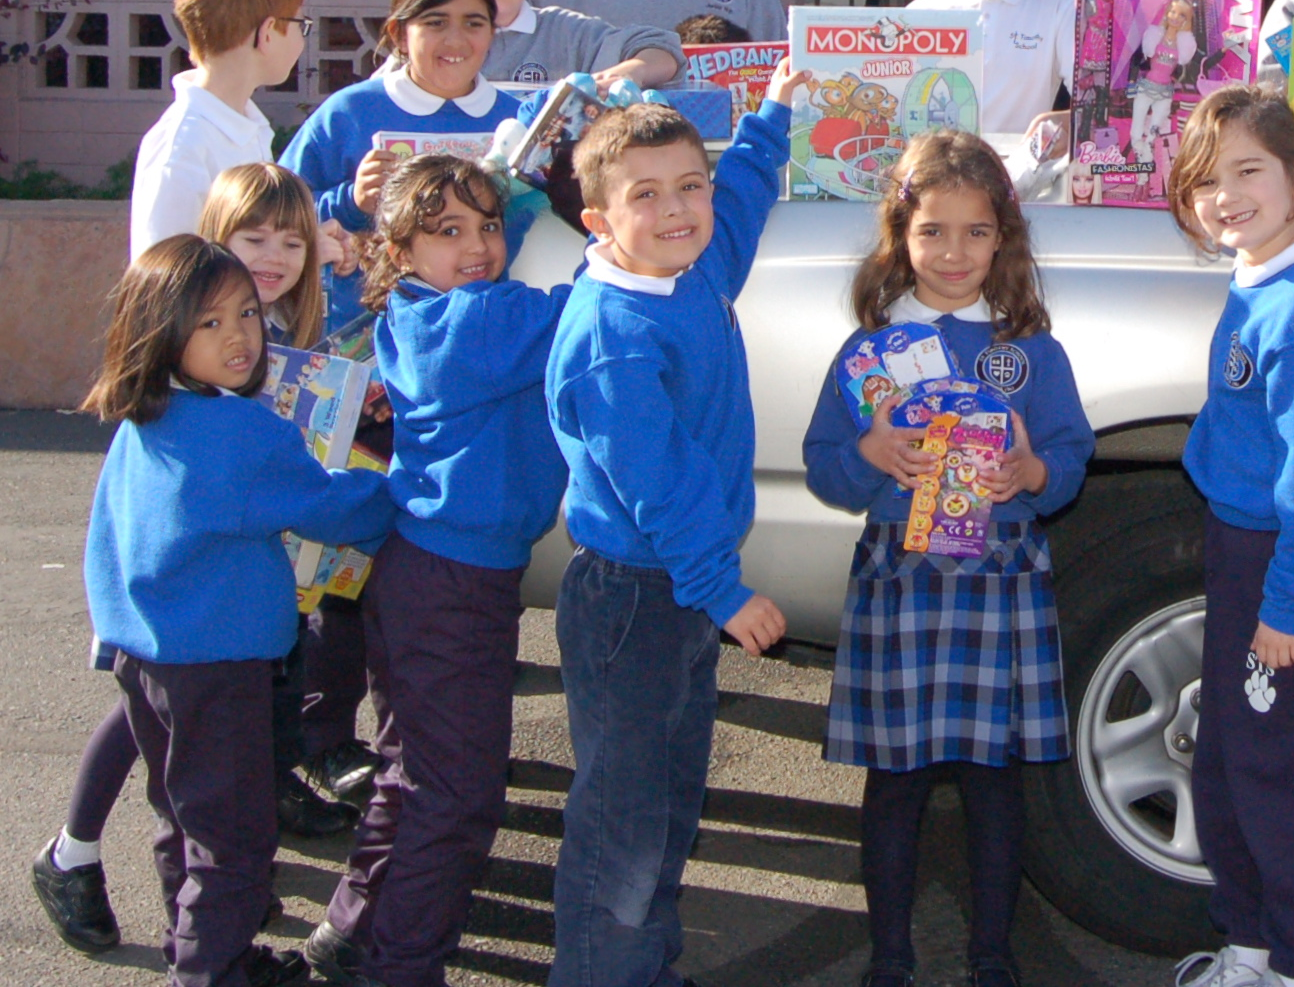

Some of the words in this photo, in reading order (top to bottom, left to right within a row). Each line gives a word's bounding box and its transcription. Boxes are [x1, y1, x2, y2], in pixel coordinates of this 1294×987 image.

[809, 28, 966, 54] MONOPOLY
[863, 60, 912, 77] JUNIOR
[1079, 141, 1126, 164] Barbie
[1092, 163, 1153, 172] FASHIONISTAS
